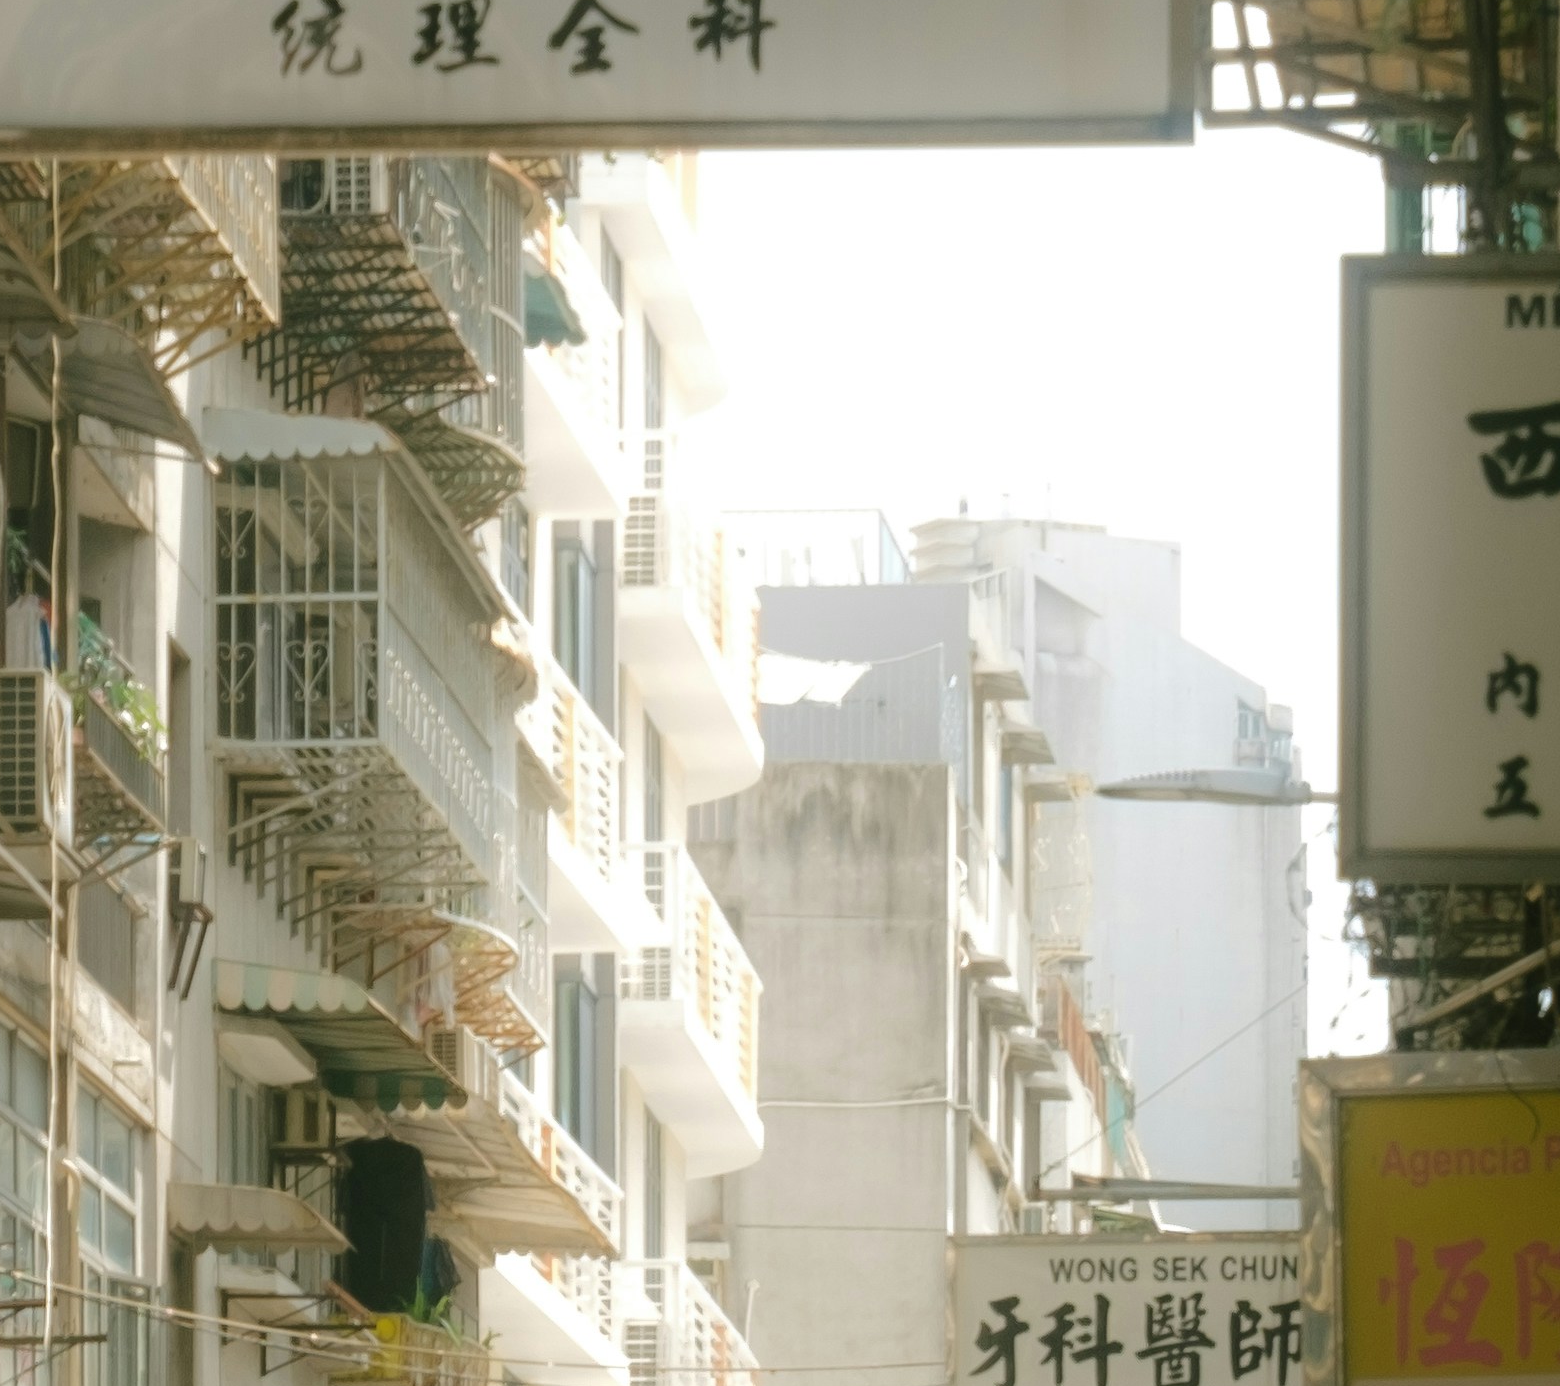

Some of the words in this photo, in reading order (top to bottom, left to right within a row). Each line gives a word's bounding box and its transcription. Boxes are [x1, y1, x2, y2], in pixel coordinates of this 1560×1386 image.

[1048, 1257, 1138, 1284] WONG
[1152, 1256, 1208, 1283] SEK
[1220, 1255, 1298, 1282] CHUN
